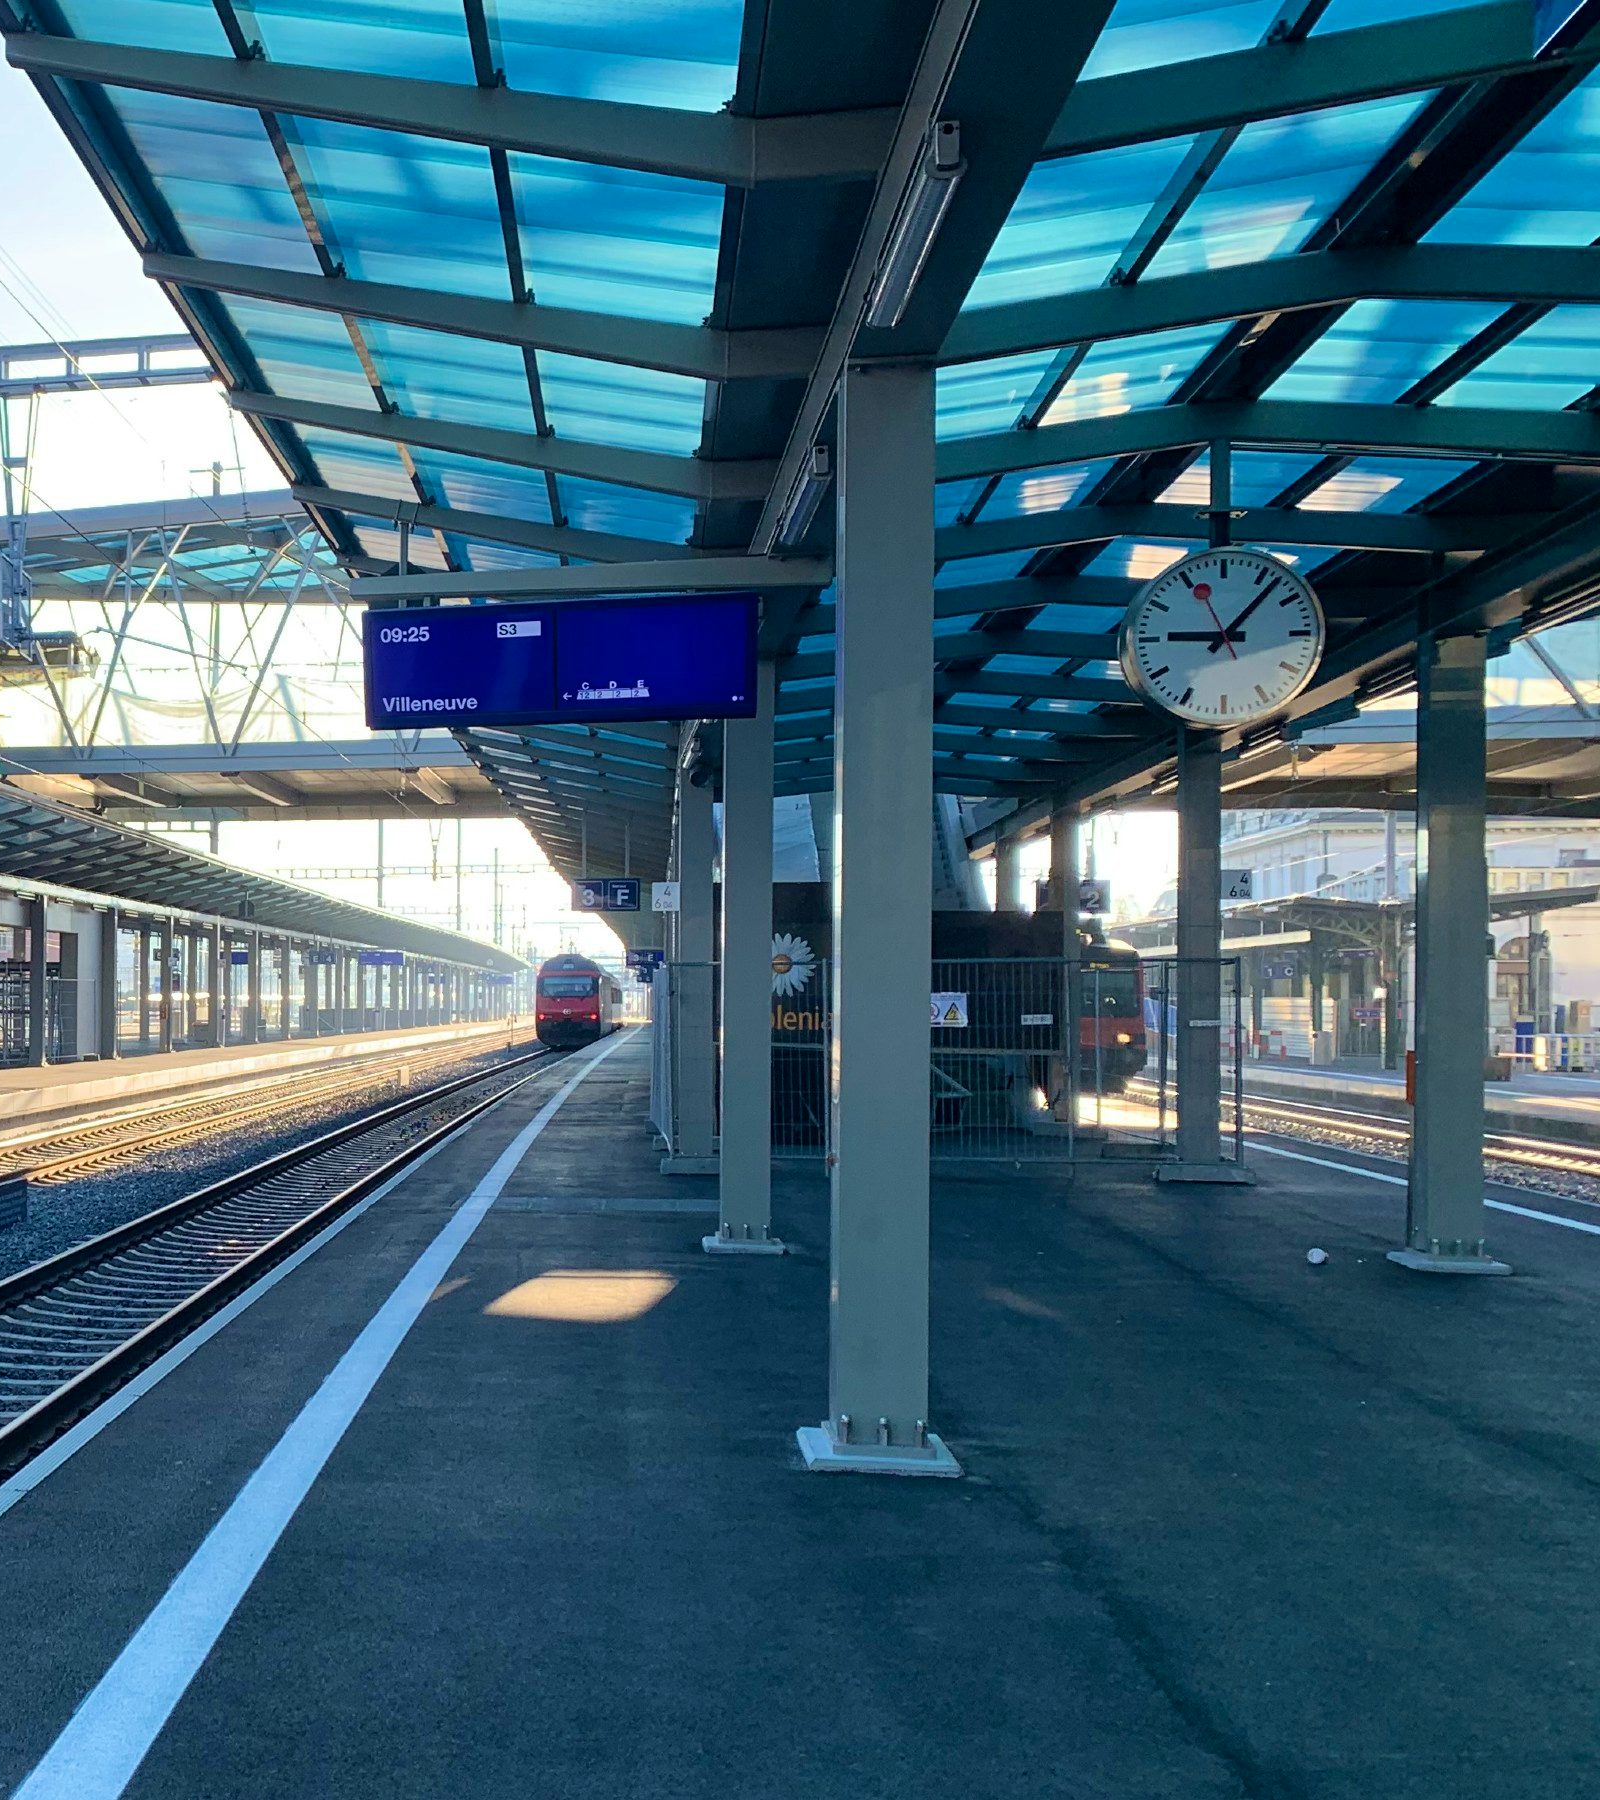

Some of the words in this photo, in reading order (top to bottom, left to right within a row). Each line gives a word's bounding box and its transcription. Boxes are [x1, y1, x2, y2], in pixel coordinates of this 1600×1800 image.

[380, 626, 430, 643] 09:25
[499, 624, 517, 636] S3
[581, 682, 590, 690] C
[609, 681, 617, 689] D
[637, 680, 644, 688] E
[383, 697, 478, 712] Villeneuve
[1240, 872, 1249, 885] 4
[664, 886, 671, 897] 4
[1230, 885, 1237, 897] 6
[1240, 889, 1250, 897] 04
[582, 889, 595, 907] 3
[616, 889, 629, 906] F
[654, 898, 661, 909] 6
[1086, 891, 1099, 908] 2
[312, 955, 319, 963] E
[326, 955, 332, 963] 4
[634, 954, 640, 962] 3
[647, 954, 654, 962] E
[1267, 968, 1272, 977] 1
